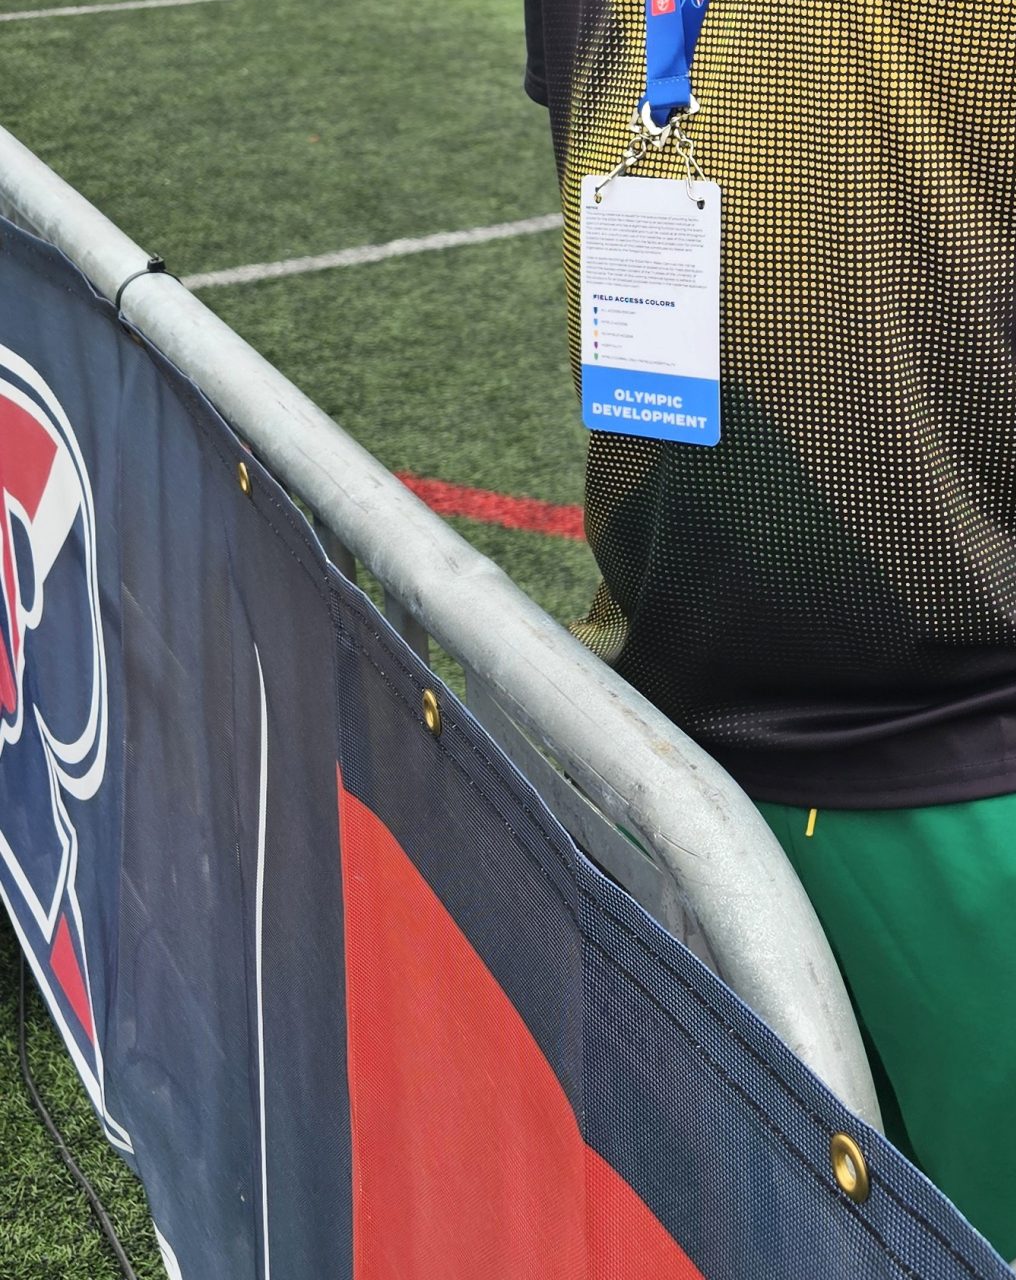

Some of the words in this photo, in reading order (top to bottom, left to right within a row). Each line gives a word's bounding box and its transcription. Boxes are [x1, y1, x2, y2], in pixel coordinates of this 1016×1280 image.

[614, 296, 644, 305] ACCESS
[644, 299, 676, 308] COLORS
[614, 388, 683, 409] OLYMPIC
[592, 402, 707, 429] DEVELOPMENT
